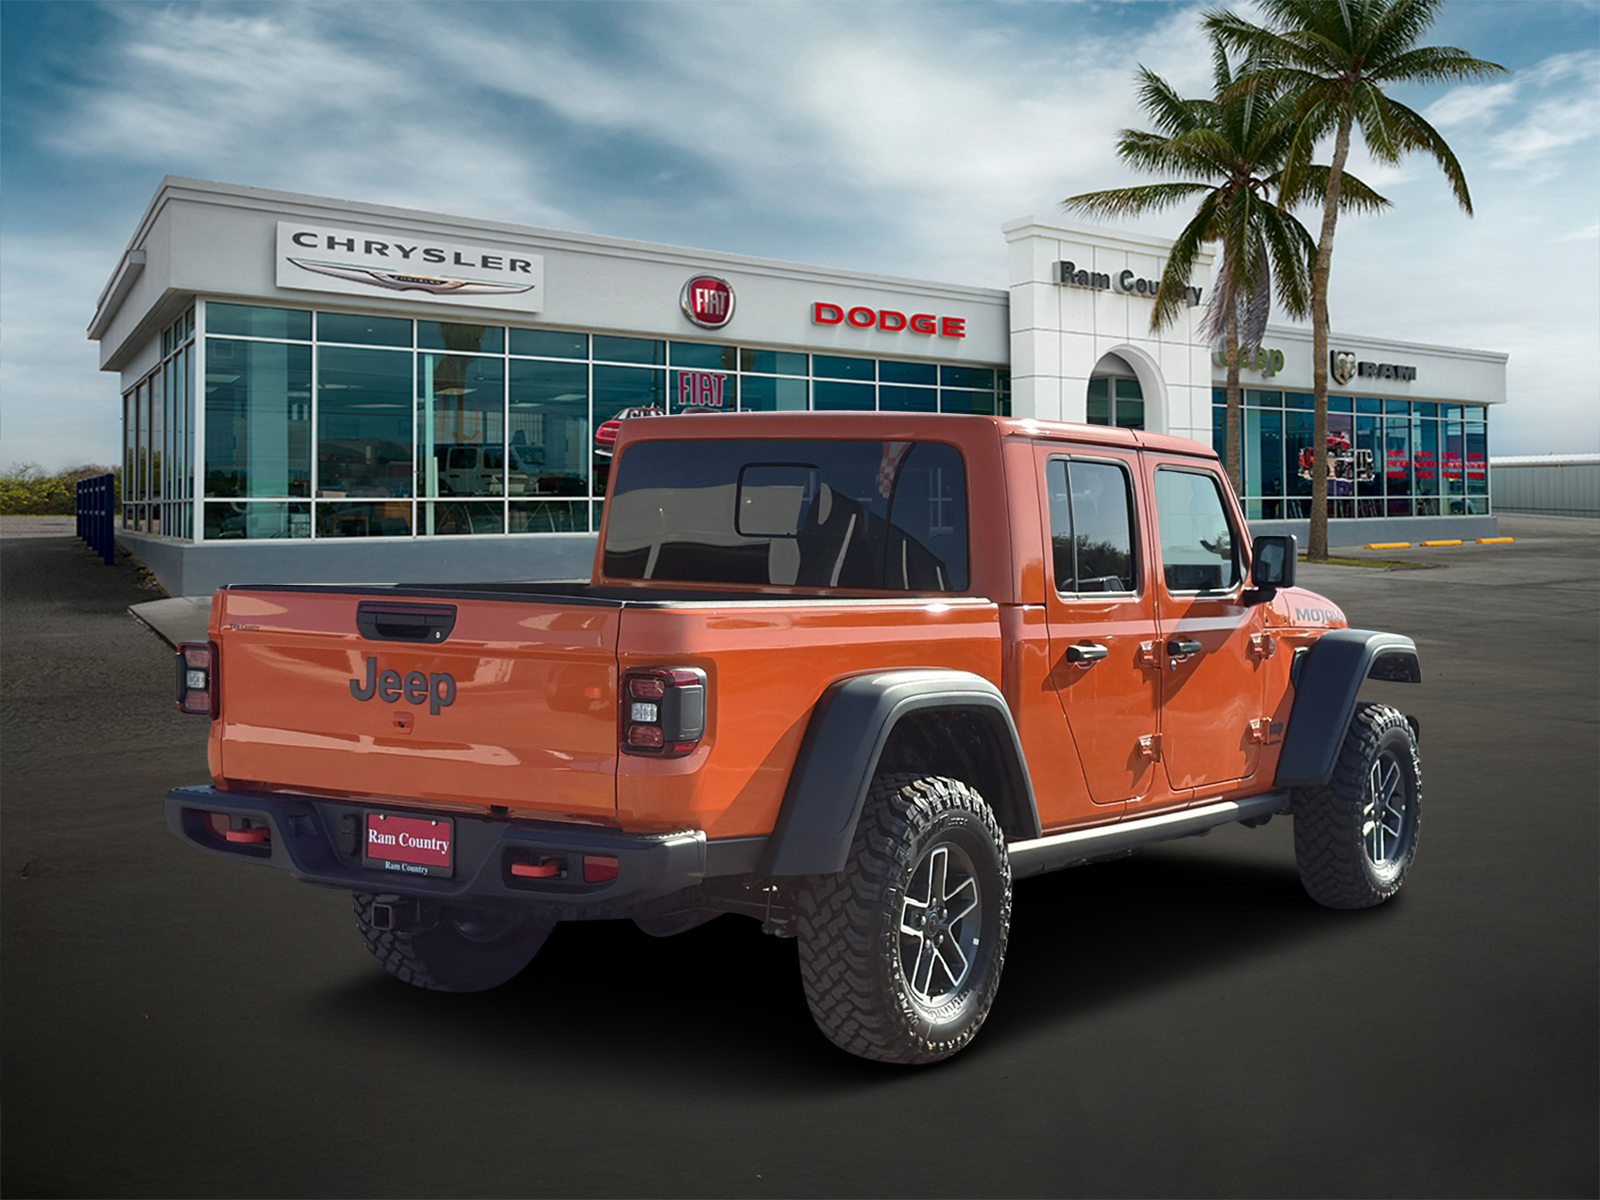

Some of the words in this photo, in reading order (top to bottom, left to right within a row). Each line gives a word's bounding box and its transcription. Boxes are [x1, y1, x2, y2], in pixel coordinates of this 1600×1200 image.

[291, 231, 533, 274] CHRYSLER
[1053, 260, 1110, 290] Ram
[1113, 269, 1203, 306] Coury
[696, 287, 728, 316] FIAT
[812, 301, 968, 339] DODGE
[677, 371, 727, 407] FIAT
[1357, 361, 1417, 381] RAM
[349, 656, 456, 716] Jeep
[368, 828, 396, 846] Ram
[398, 832, 450, 855] Country
[385, 861, 400, 871] Ram
[401, 863, 428, 875] Country
